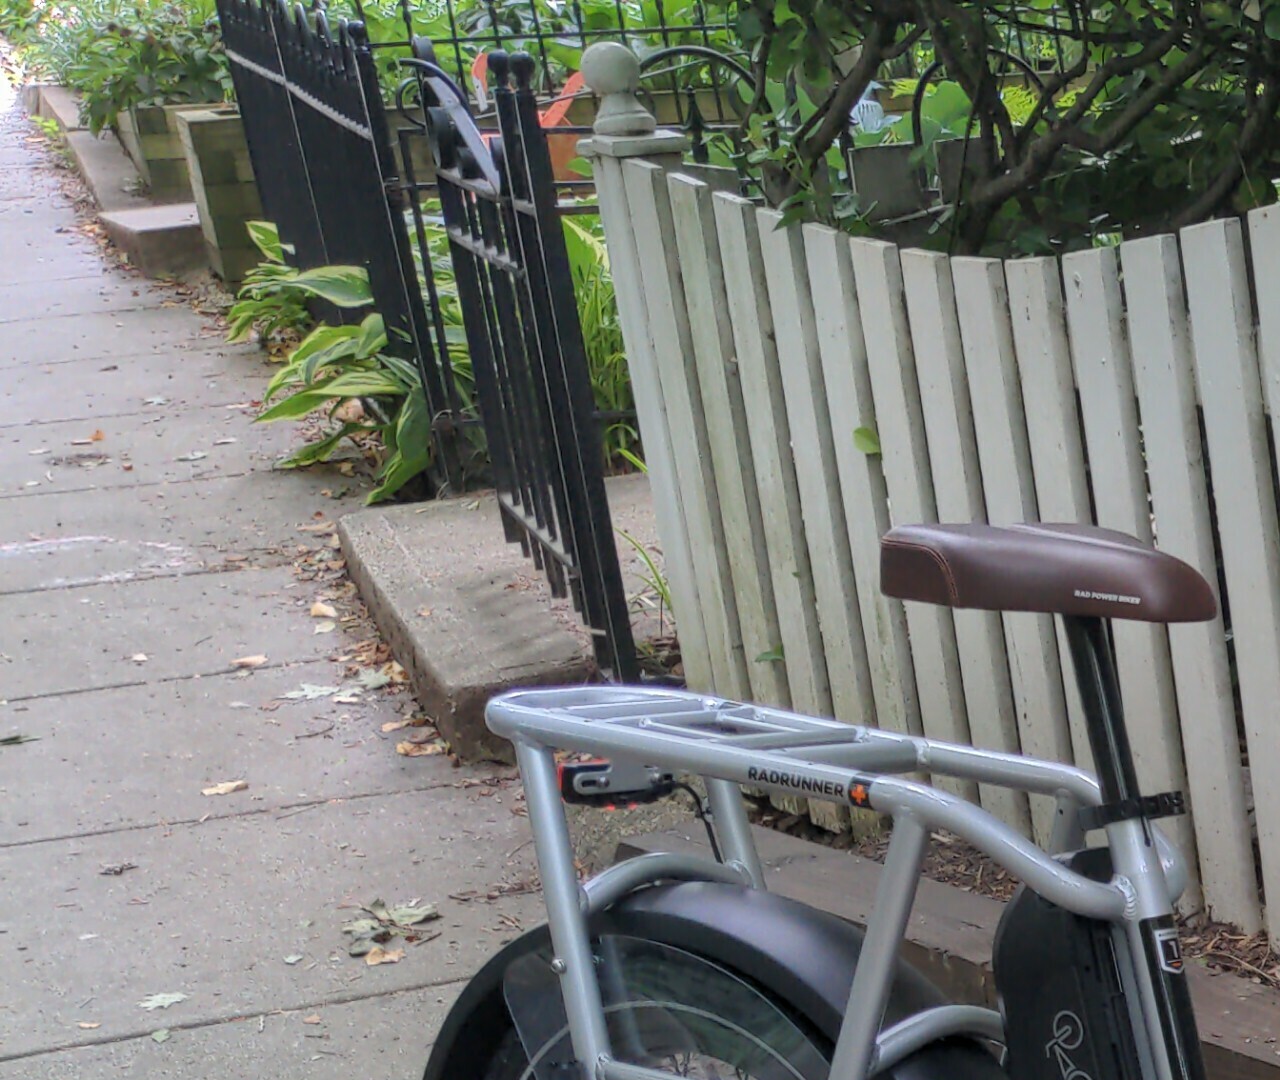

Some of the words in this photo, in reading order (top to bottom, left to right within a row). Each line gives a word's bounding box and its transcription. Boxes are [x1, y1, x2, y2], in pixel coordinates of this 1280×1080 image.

[1073, 589, 1091, 598] RAD
[1091, 592, 1118, 602] POWER
[748, 766, 844, 797] RADRUNNER
